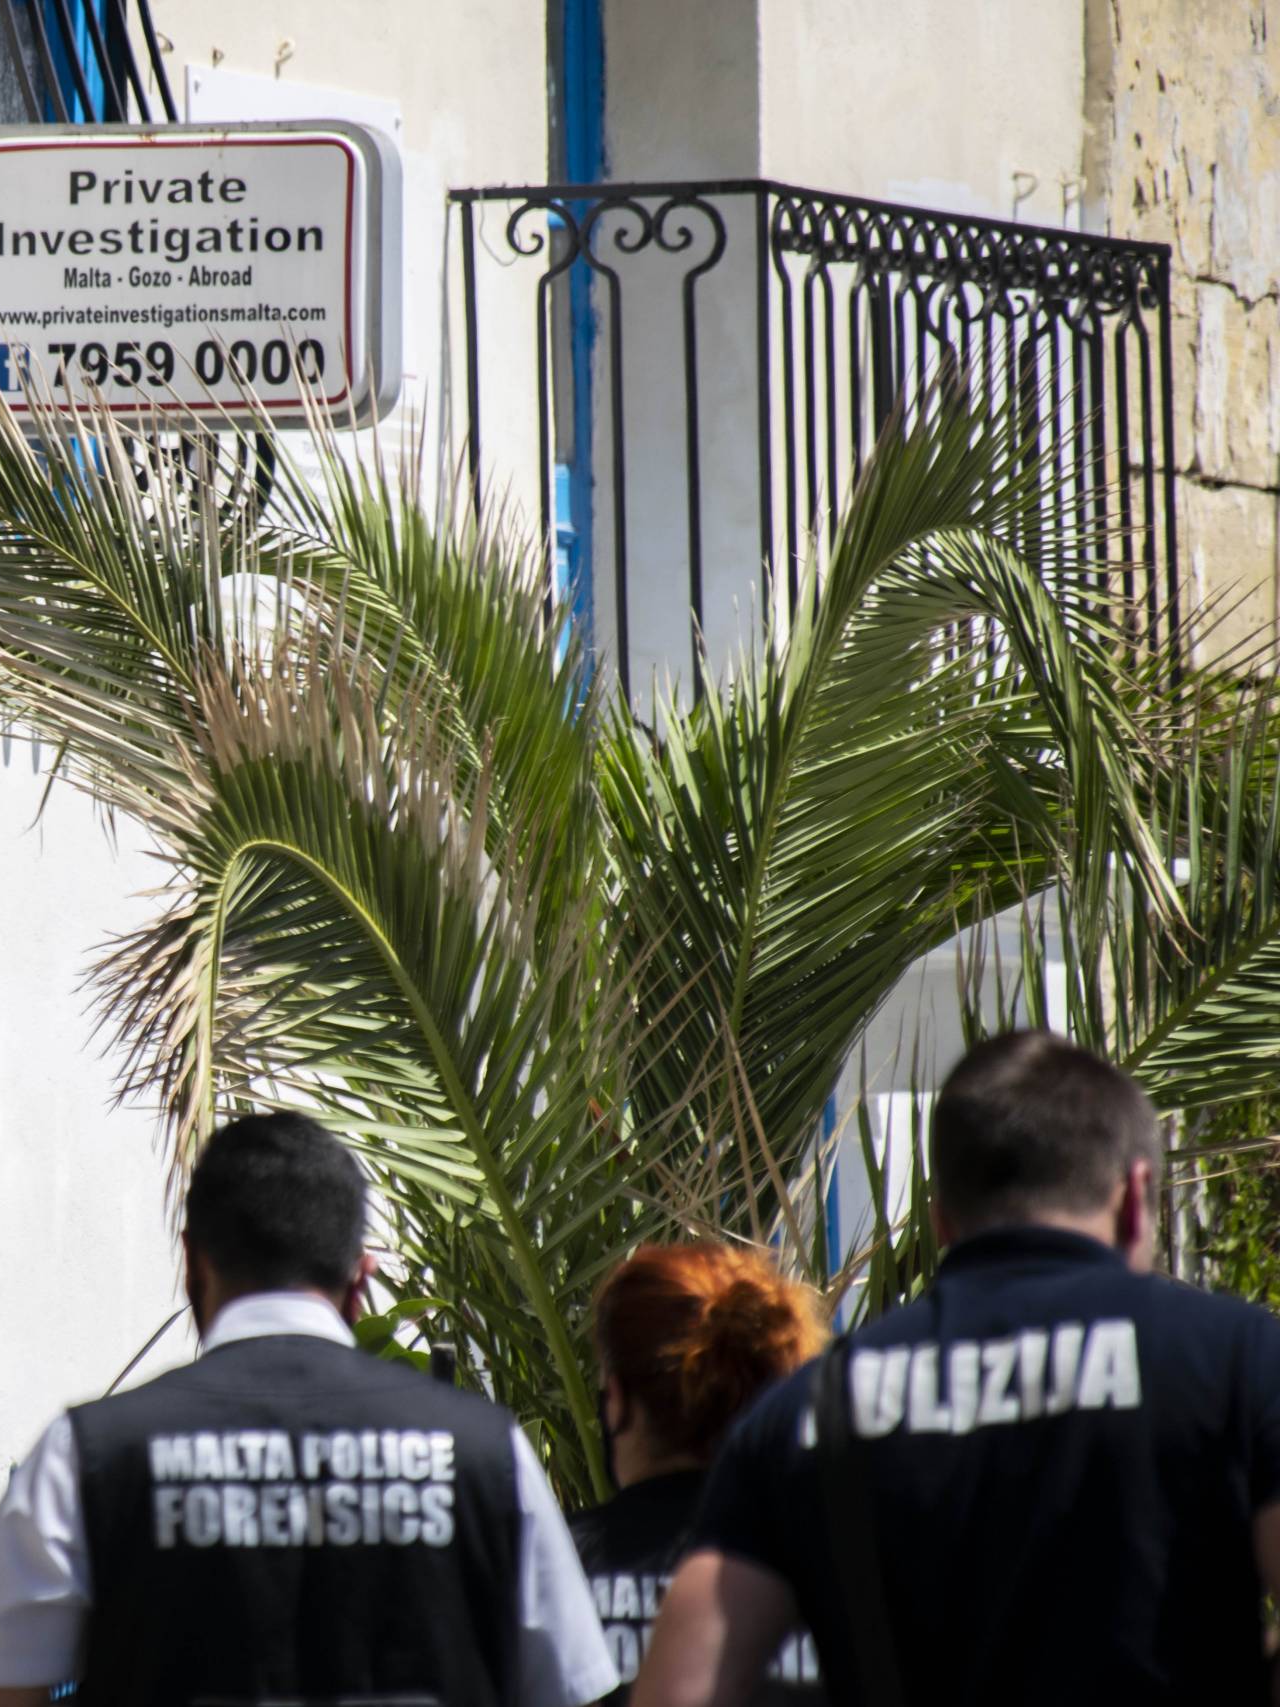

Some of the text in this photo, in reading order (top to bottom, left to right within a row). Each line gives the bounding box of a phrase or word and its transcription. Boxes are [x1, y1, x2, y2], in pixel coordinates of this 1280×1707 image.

[68, 170, 248, 205] Private
[63, 267, 112, 290] Malta
[128, 265, 172, 289] Gozo
[189, 264, 253, 287] Abroad
[47, 341, 175, 389] 7959
[195, 338, 326, 388] 0000
[797, 1317, 1143, 1451] ULIZIJA
[149, 1428, 456, 1482] MALTA POLICE
[155, 1482, 456, 1550] FORENSICS
